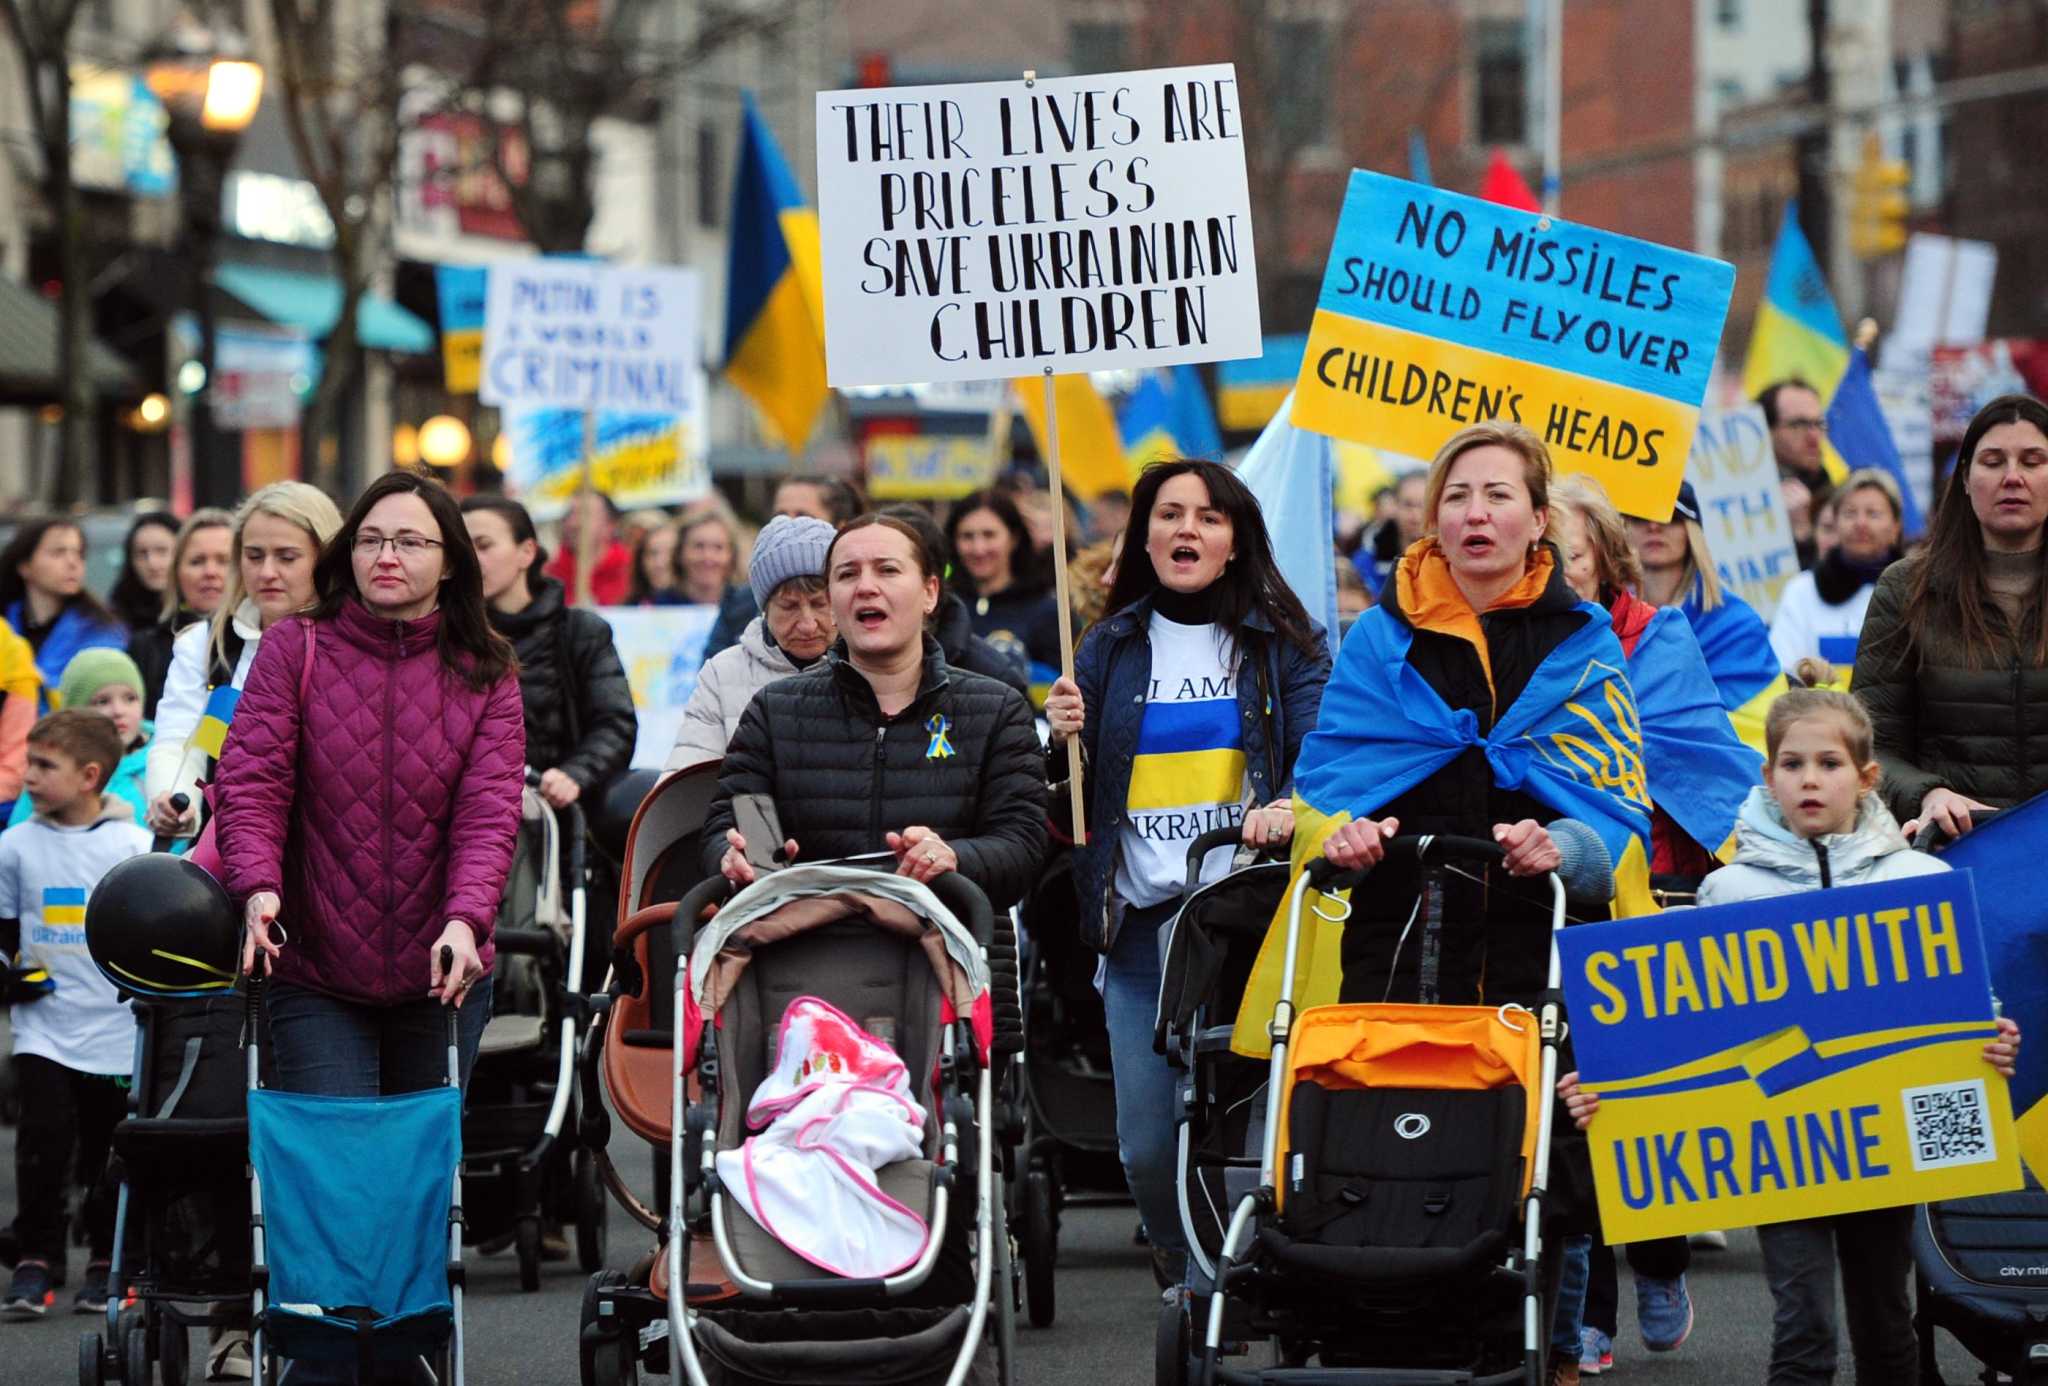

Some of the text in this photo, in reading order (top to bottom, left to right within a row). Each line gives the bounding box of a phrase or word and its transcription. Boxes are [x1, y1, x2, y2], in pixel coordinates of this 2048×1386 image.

[832, 80, 1238, 162] THEIR LIVES ARE
[881, 157, 1154, 231] PRICELESS
[1396, 201, 1466, 258] NO
[861, 215, 1238, 297] SAVE UKRAINIAN
[930, 286, 1207, 361] CHILDREN
[1337, 258, 1689, 376] SHOULD FLY OVER
[1316, 347, 1665, 467] CHILDREN'S HEADS
[1692, 412, 1766, 479] ND
[1709, 488, 1776, 541] TH
[1150, 676, 1231, 699] I AM
[32, 926, 86, 944] Ukrain
[1584, 901, 1963, 1025] STAND WITH
[1613, 1104, 1890, 1210] UKRAINE
[2000, 1264, 2025, 1277] city
